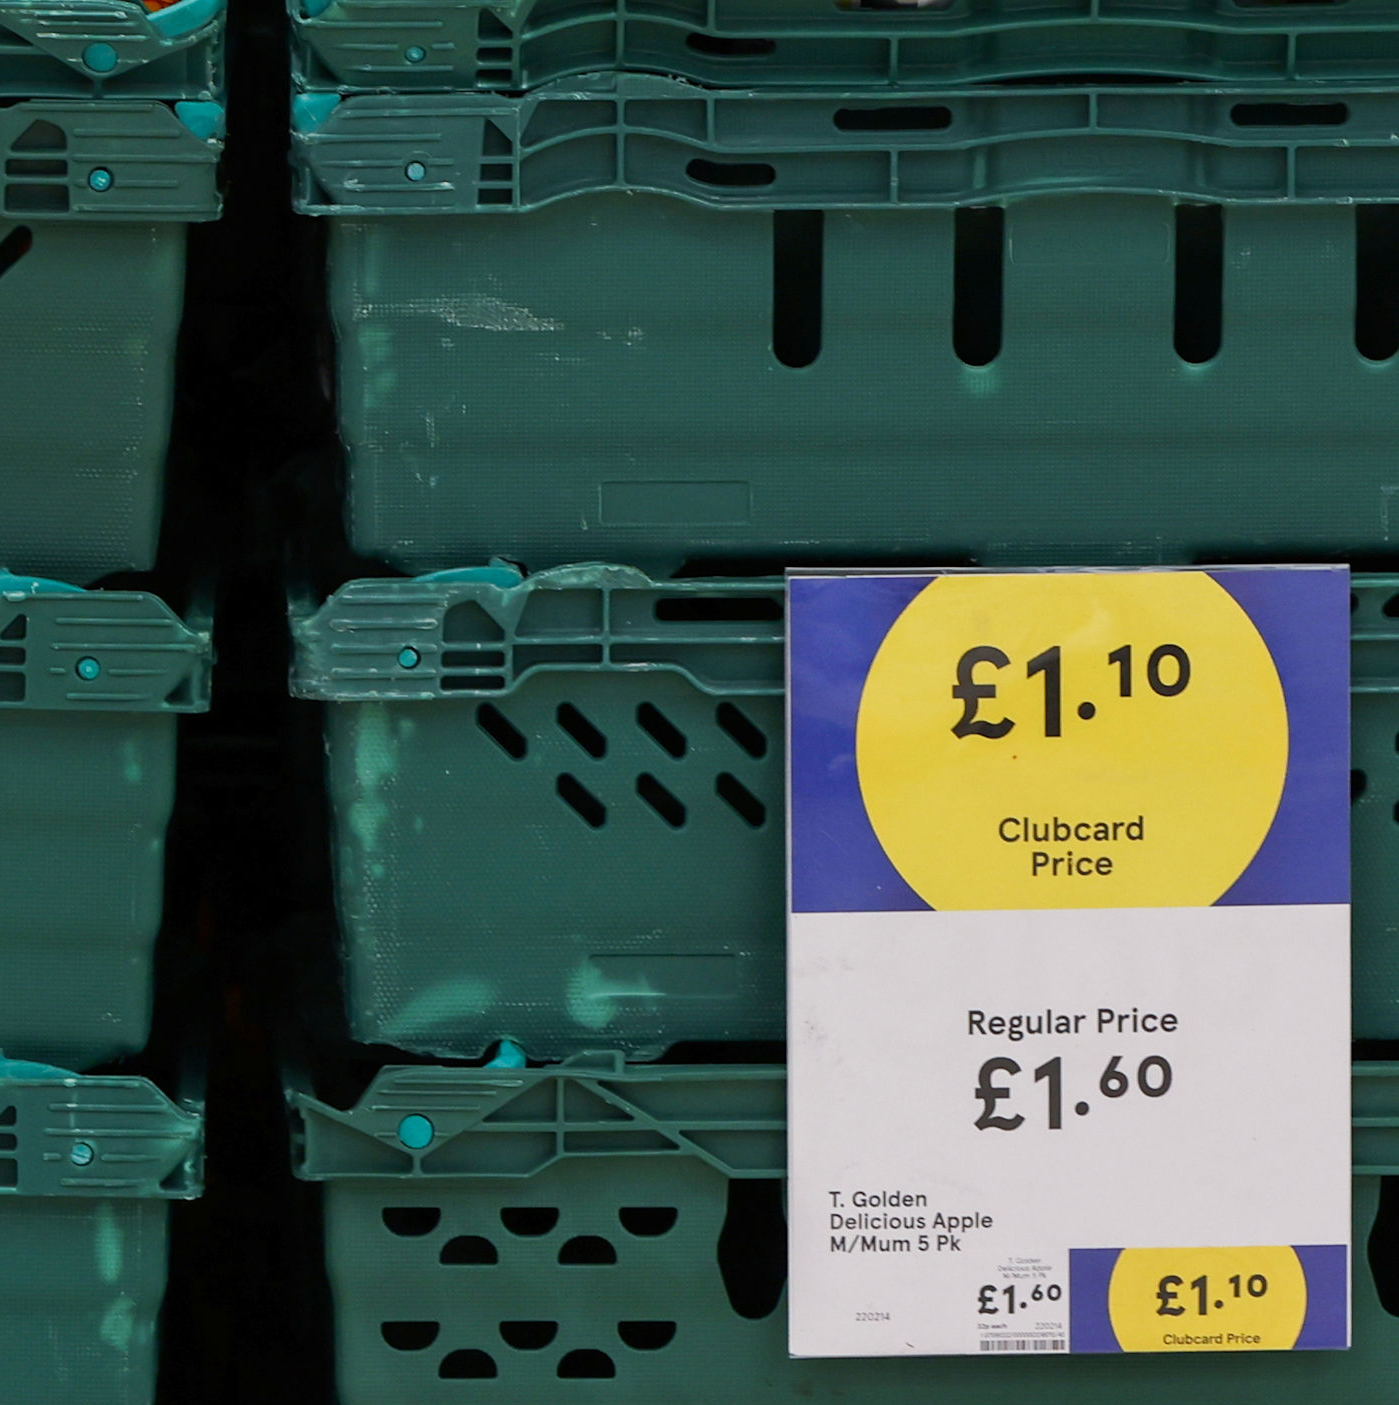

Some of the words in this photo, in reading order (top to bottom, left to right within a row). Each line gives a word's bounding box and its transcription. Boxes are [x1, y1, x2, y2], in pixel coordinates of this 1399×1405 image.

[951, 645, 1191, 741] £1.10
[998, 816, 1145, 843] Clubcard
[1031, 852, 1113, 878] Price
[968, 1009, 1086, 1041] Regular
[1098, 1008, 1178, 1033] Price
[974, 1055, 1173, 1131] £1.60
[829, 1191, 845, 1208] T.
[852, 1190, 928, 1208] Golden
[830, 1213, 926, 1230] Delicious
[932, 1212, 993, 1233] Apple
[830, 1235, 911, 1253] M/Mum
[918, 1235, 929, 1251] 5
[937, 1235, 961, 1251] Pk
[977, 1284, 1062, 1314] £1.60
[1156, 1274, 1268, 1316] £1.10
[1163, 1333, 1222, 1344] Clubcard
[1227, 1333, 1261, 1344] Price
